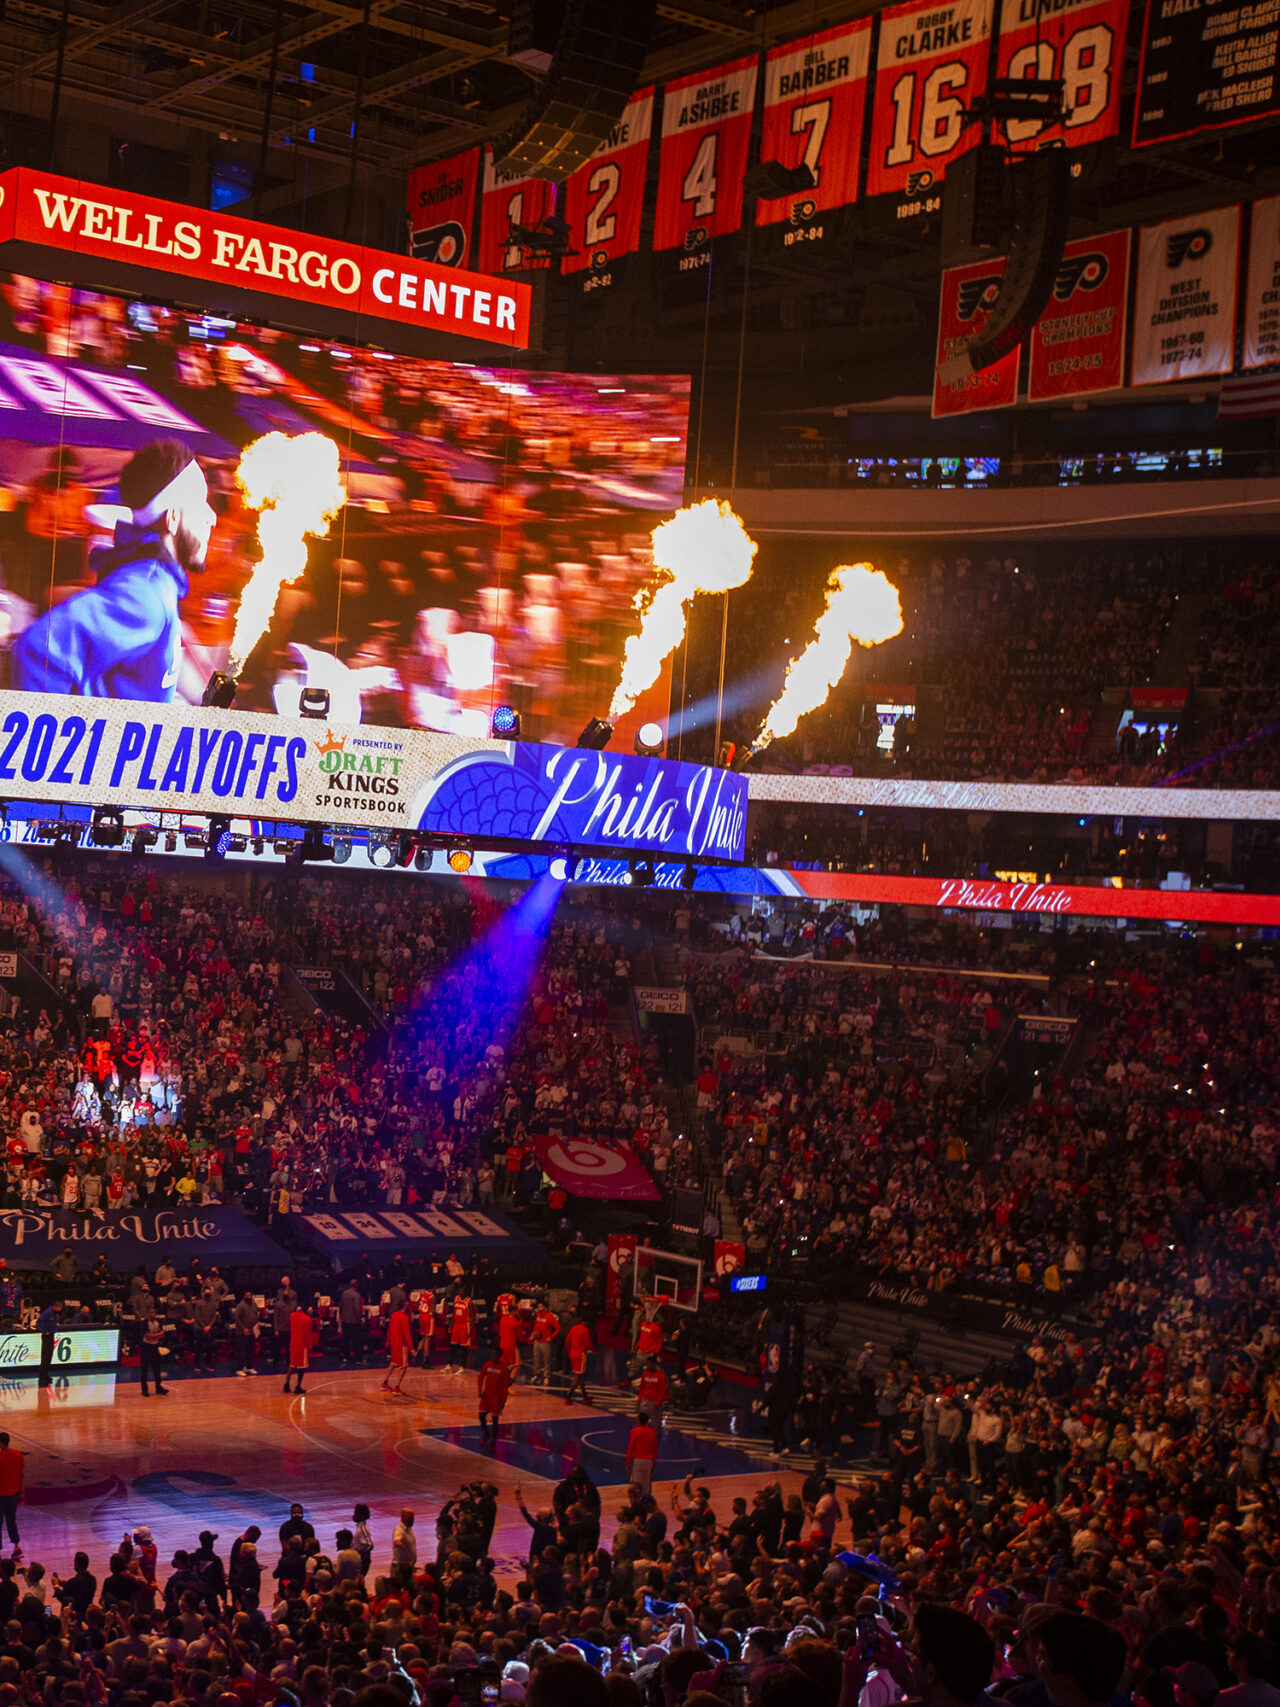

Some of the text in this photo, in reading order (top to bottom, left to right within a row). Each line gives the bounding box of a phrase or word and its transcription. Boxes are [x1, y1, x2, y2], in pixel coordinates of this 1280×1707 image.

[917, 10, 955, 30] BOBBY
[896, 19, 972, 58] CLARKE
[1247, 29, 1279, 49] ALLEN
[804, 50, 826, 67] BILL
[1234, 42, 1277, 63] BARBER
[779, 56, 850, 96] BARBER
[695, 82, 728, 101] BARRY
[1235, 87, 1273, 107] SHERO
[678, 91, 740, 128] ASHBEE
[886, 60, 969, 168] 16
[790, 97, 832, 188] 7
[682, 132, 718, 218] 4
[584, 161, 622, 248] 2
[32, 187, 518, 332] WELLS FARGO CENTER
[1170, 278, 1202, 295] WEST
[1159, 290, 1211, 311] DIVISION
[1039, 306, 1116, 334] STANLEY CUP
[1151, 303, 1219, 326] CHAMPIONS
[1041, 321, 1112, 347] CHAMPIONS
[1048, 352, 1103, 377] 1974-75
[352, 738, 404, 751] PRESENTED BY
[109, 721, 307, 803] PLAYOFFS
[318, 750, 404, 776] DRAFT
[327, 771, 400, 796] KINGS
[315, 795, 406, 814] SPORTSBOOK
[531, 748, 745, 854] Phila Unite
[936, 878, 1072, 912] Phila Unite
[0, 966, 15, 976] 123
[319, 980, 336, 991] 122
[640, 990, 680, 1001] GEICO
[1021, 1030, 1036, 1041] 121
[1025, 1020, 1070, 1032] GEICO
[2, 1211, 221, 1245] Phila Unite
[320, 1221, 337, 1230] 10
[356, 1220, 377, 1229] 34
[867, 1281, 929, 1307] Phila Unite
[1001, 1311, 1036, 1333] Phila
